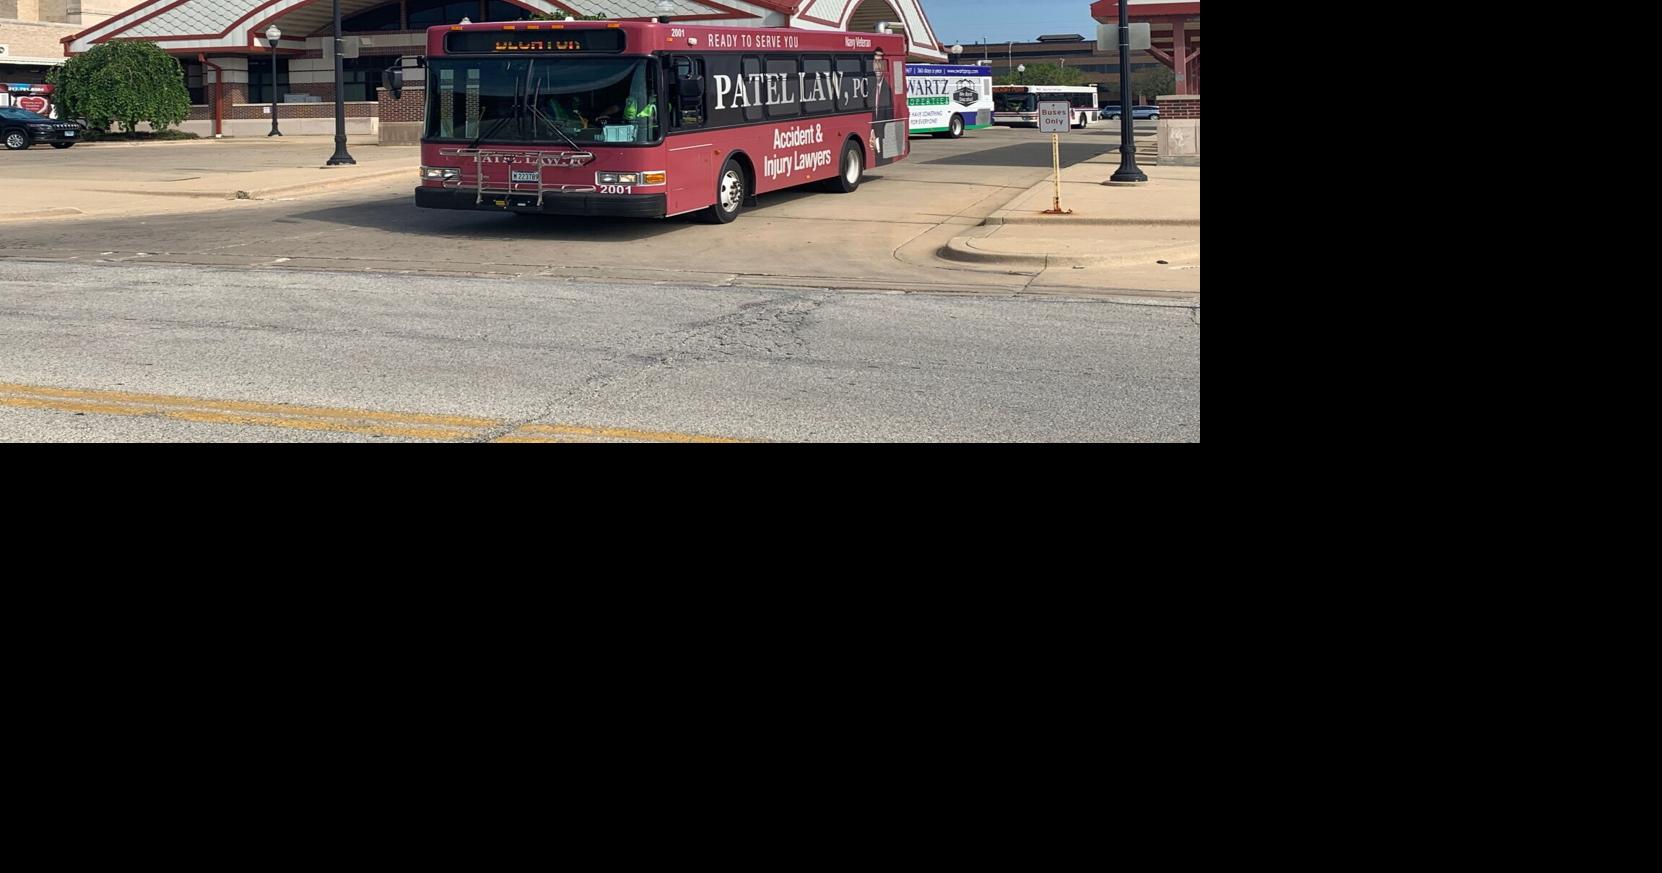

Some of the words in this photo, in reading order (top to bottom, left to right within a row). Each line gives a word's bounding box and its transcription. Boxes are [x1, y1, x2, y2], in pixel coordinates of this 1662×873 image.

[671, 28, 685, 38] 2001
[708, 34, 738, 48] READY
[742, 35, 752, 48] TO
[755, 35, 781, 48] SERVE
[784, 36, 799, 49] YOU
[855, 37, 872, 48] Veteran
[713, 73, 794, 110] PATEL
[798, 71, 850, 106] LAW,
[852, 77, 869, 99] PC
[907, 79, 950, 96] WARTZ
[1045, 118, 1064, 126] Only
[773, 125, 814, 150] Accident
[815, 123, 823, 142] &
[764, 154, 792, 180] Injury
[794, 149, 831, 172] Lawyers
[600, 185, 633, 195] 2001
